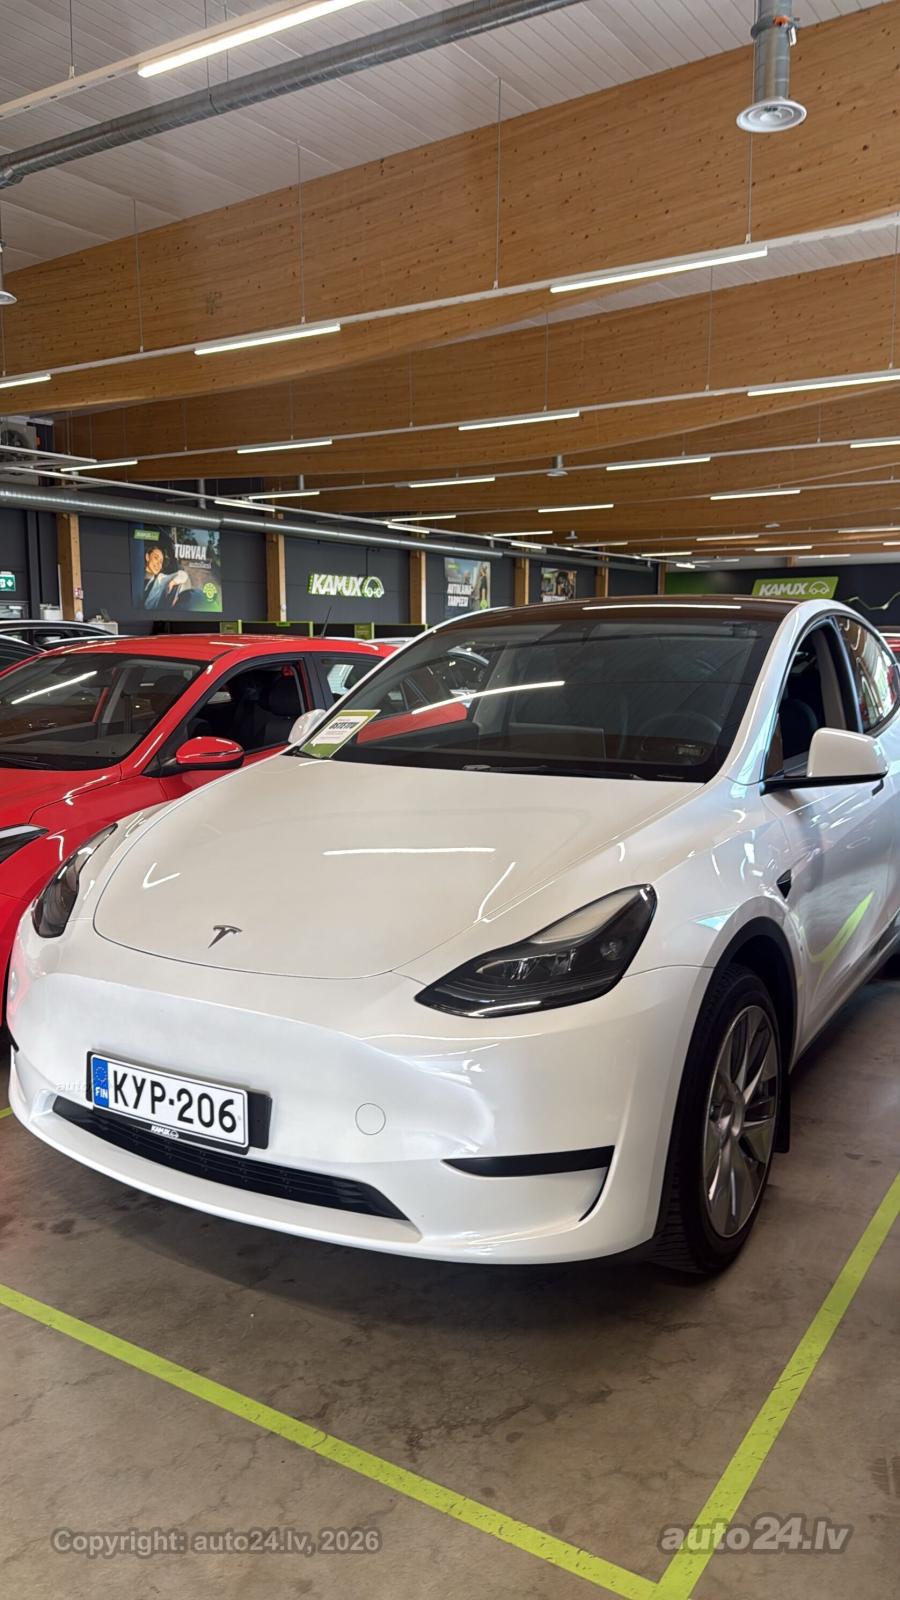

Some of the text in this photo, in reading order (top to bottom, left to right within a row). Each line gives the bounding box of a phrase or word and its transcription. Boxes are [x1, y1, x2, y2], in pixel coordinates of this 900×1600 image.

[174, 543, 206, 560] TURVAA
[311, 573, 364, 597] KAMUX
[759, 582, 808, 596] KAMUX
[95, 1086, 108, 1100] FIN
[113, 1070, 237, 1133] KYP-206
[151, 1124, 171, 1137] KAMUX
